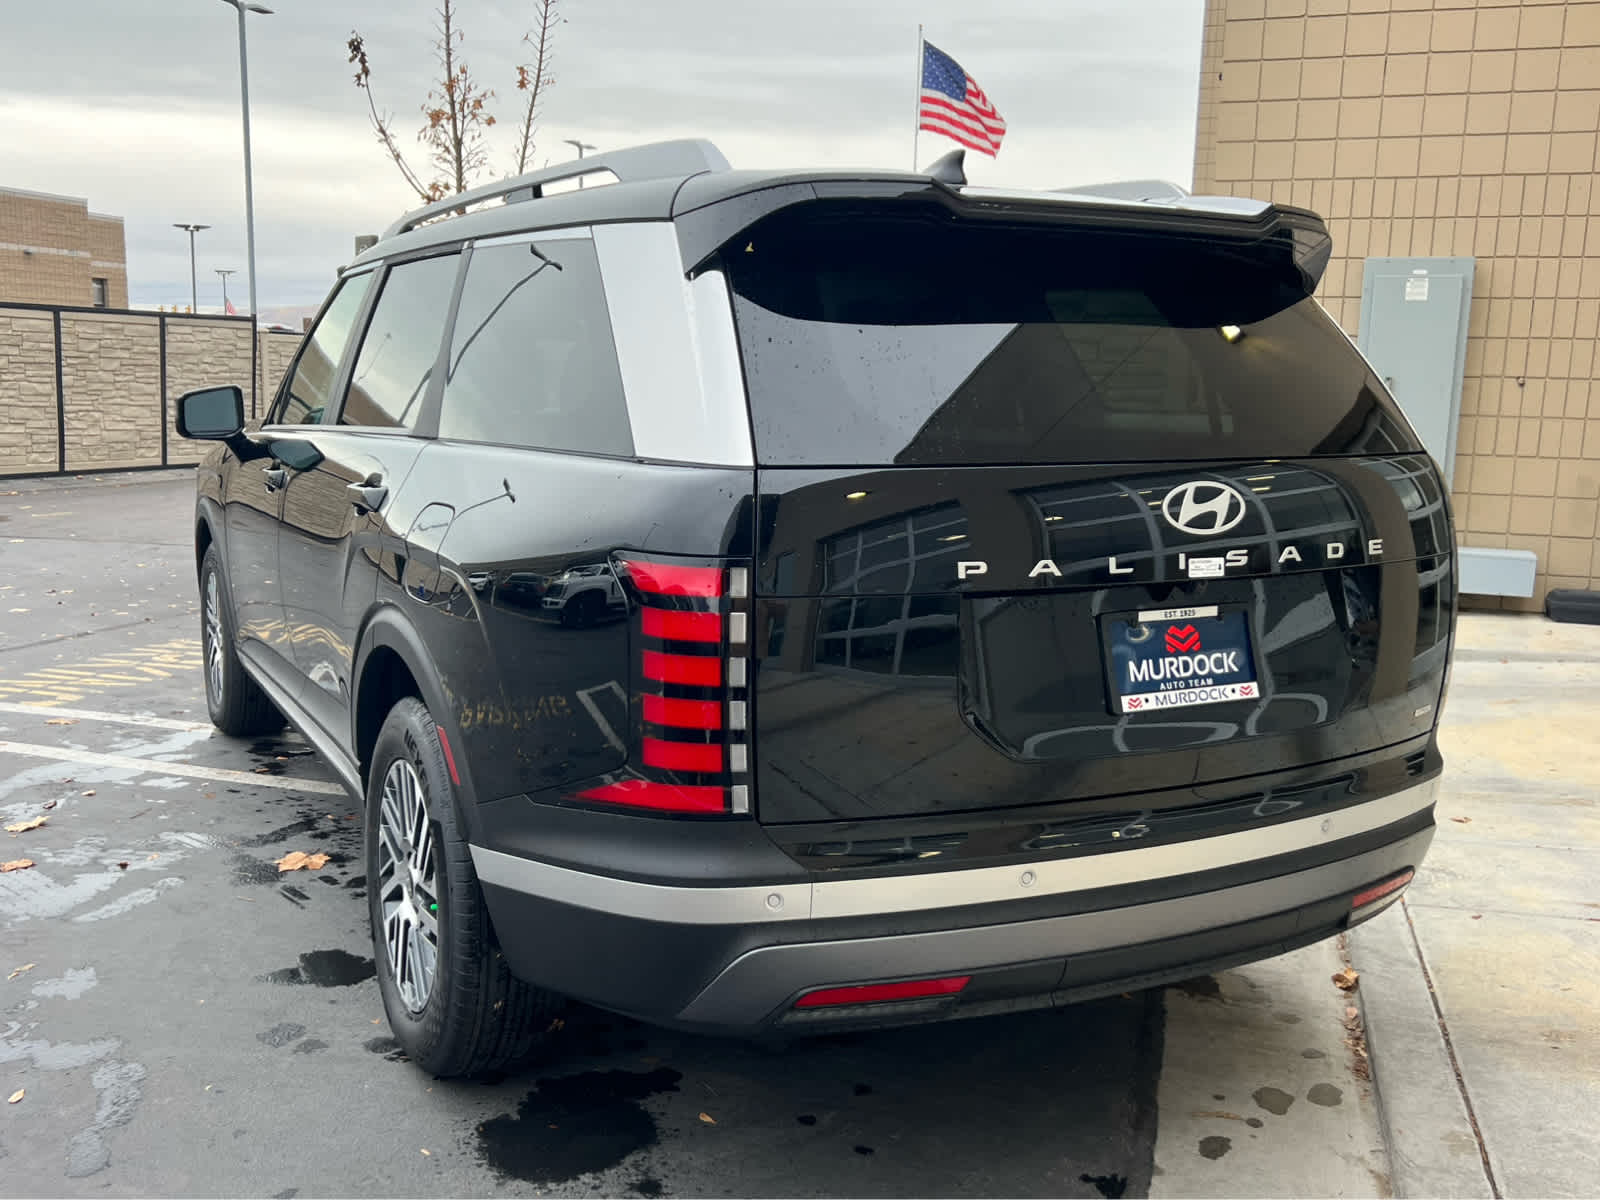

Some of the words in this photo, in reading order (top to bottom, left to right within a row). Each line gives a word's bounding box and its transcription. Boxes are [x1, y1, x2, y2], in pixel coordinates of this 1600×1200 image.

[957, 538, 1384, 580] PALISADE
[1128, 651, 1239, 682] MURDOCK
[1160, 681, 1185, 690] AUTO
[1188, 678, 1214, 687] TEAM
[1155, 687, 1229, 707] MURDOCK
